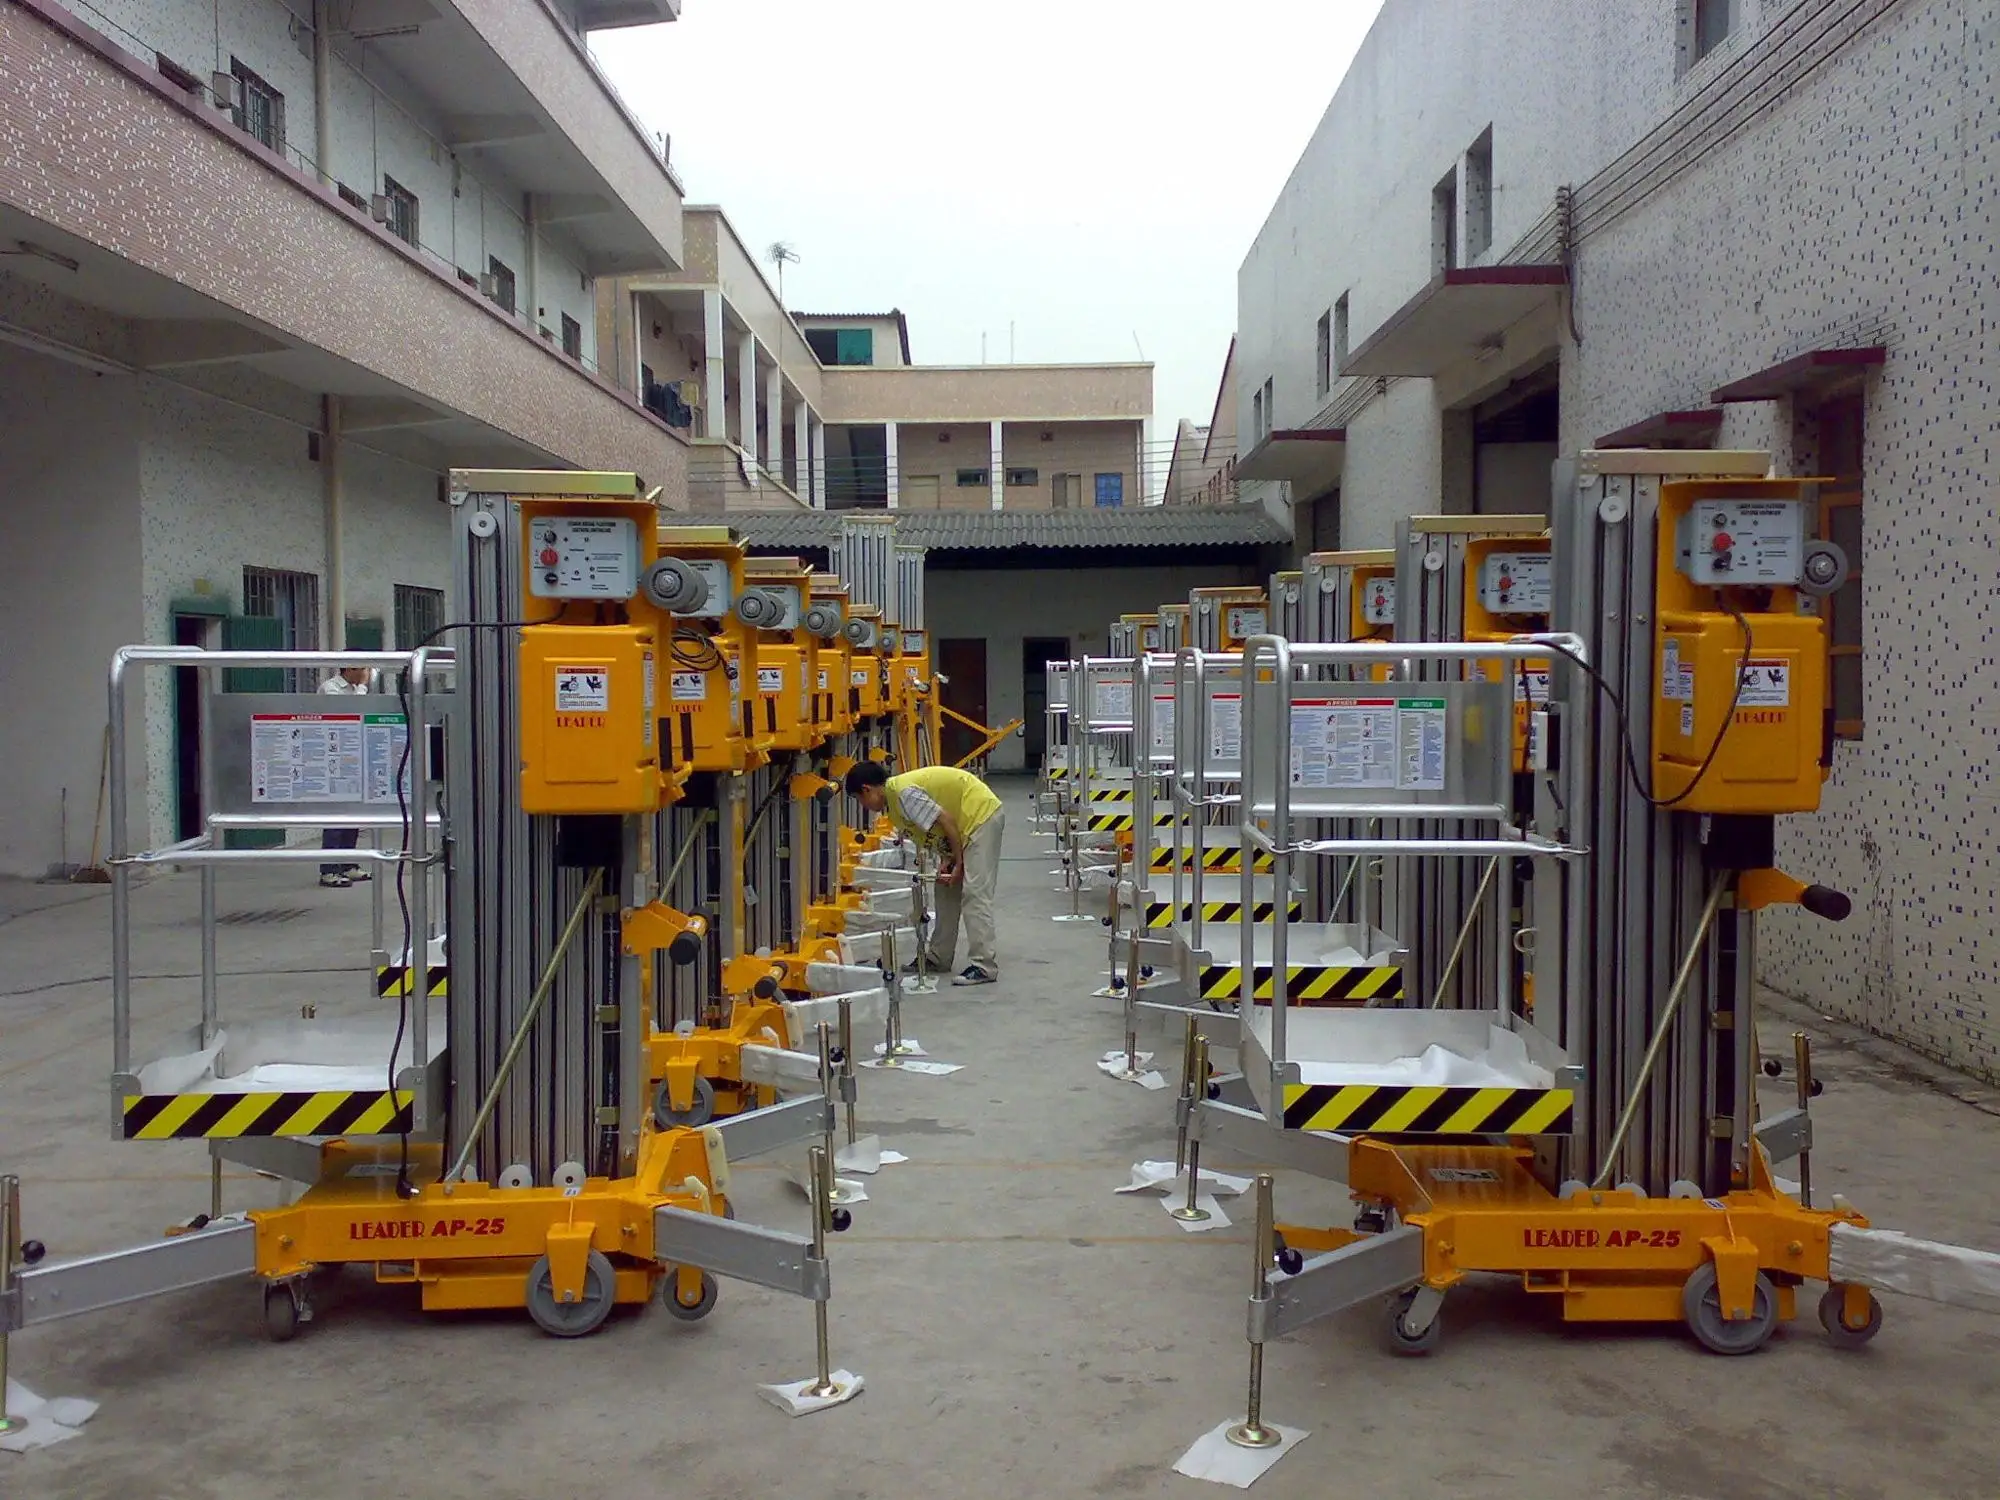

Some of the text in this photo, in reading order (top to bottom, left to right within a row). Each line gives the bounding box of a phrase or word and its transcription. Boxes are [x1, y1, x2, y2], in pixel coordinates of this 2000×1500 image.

[350, 1218, 505, 1240] LEADER AP-25
[1523, 1228, 1681, 1248] LEADER AP-25
